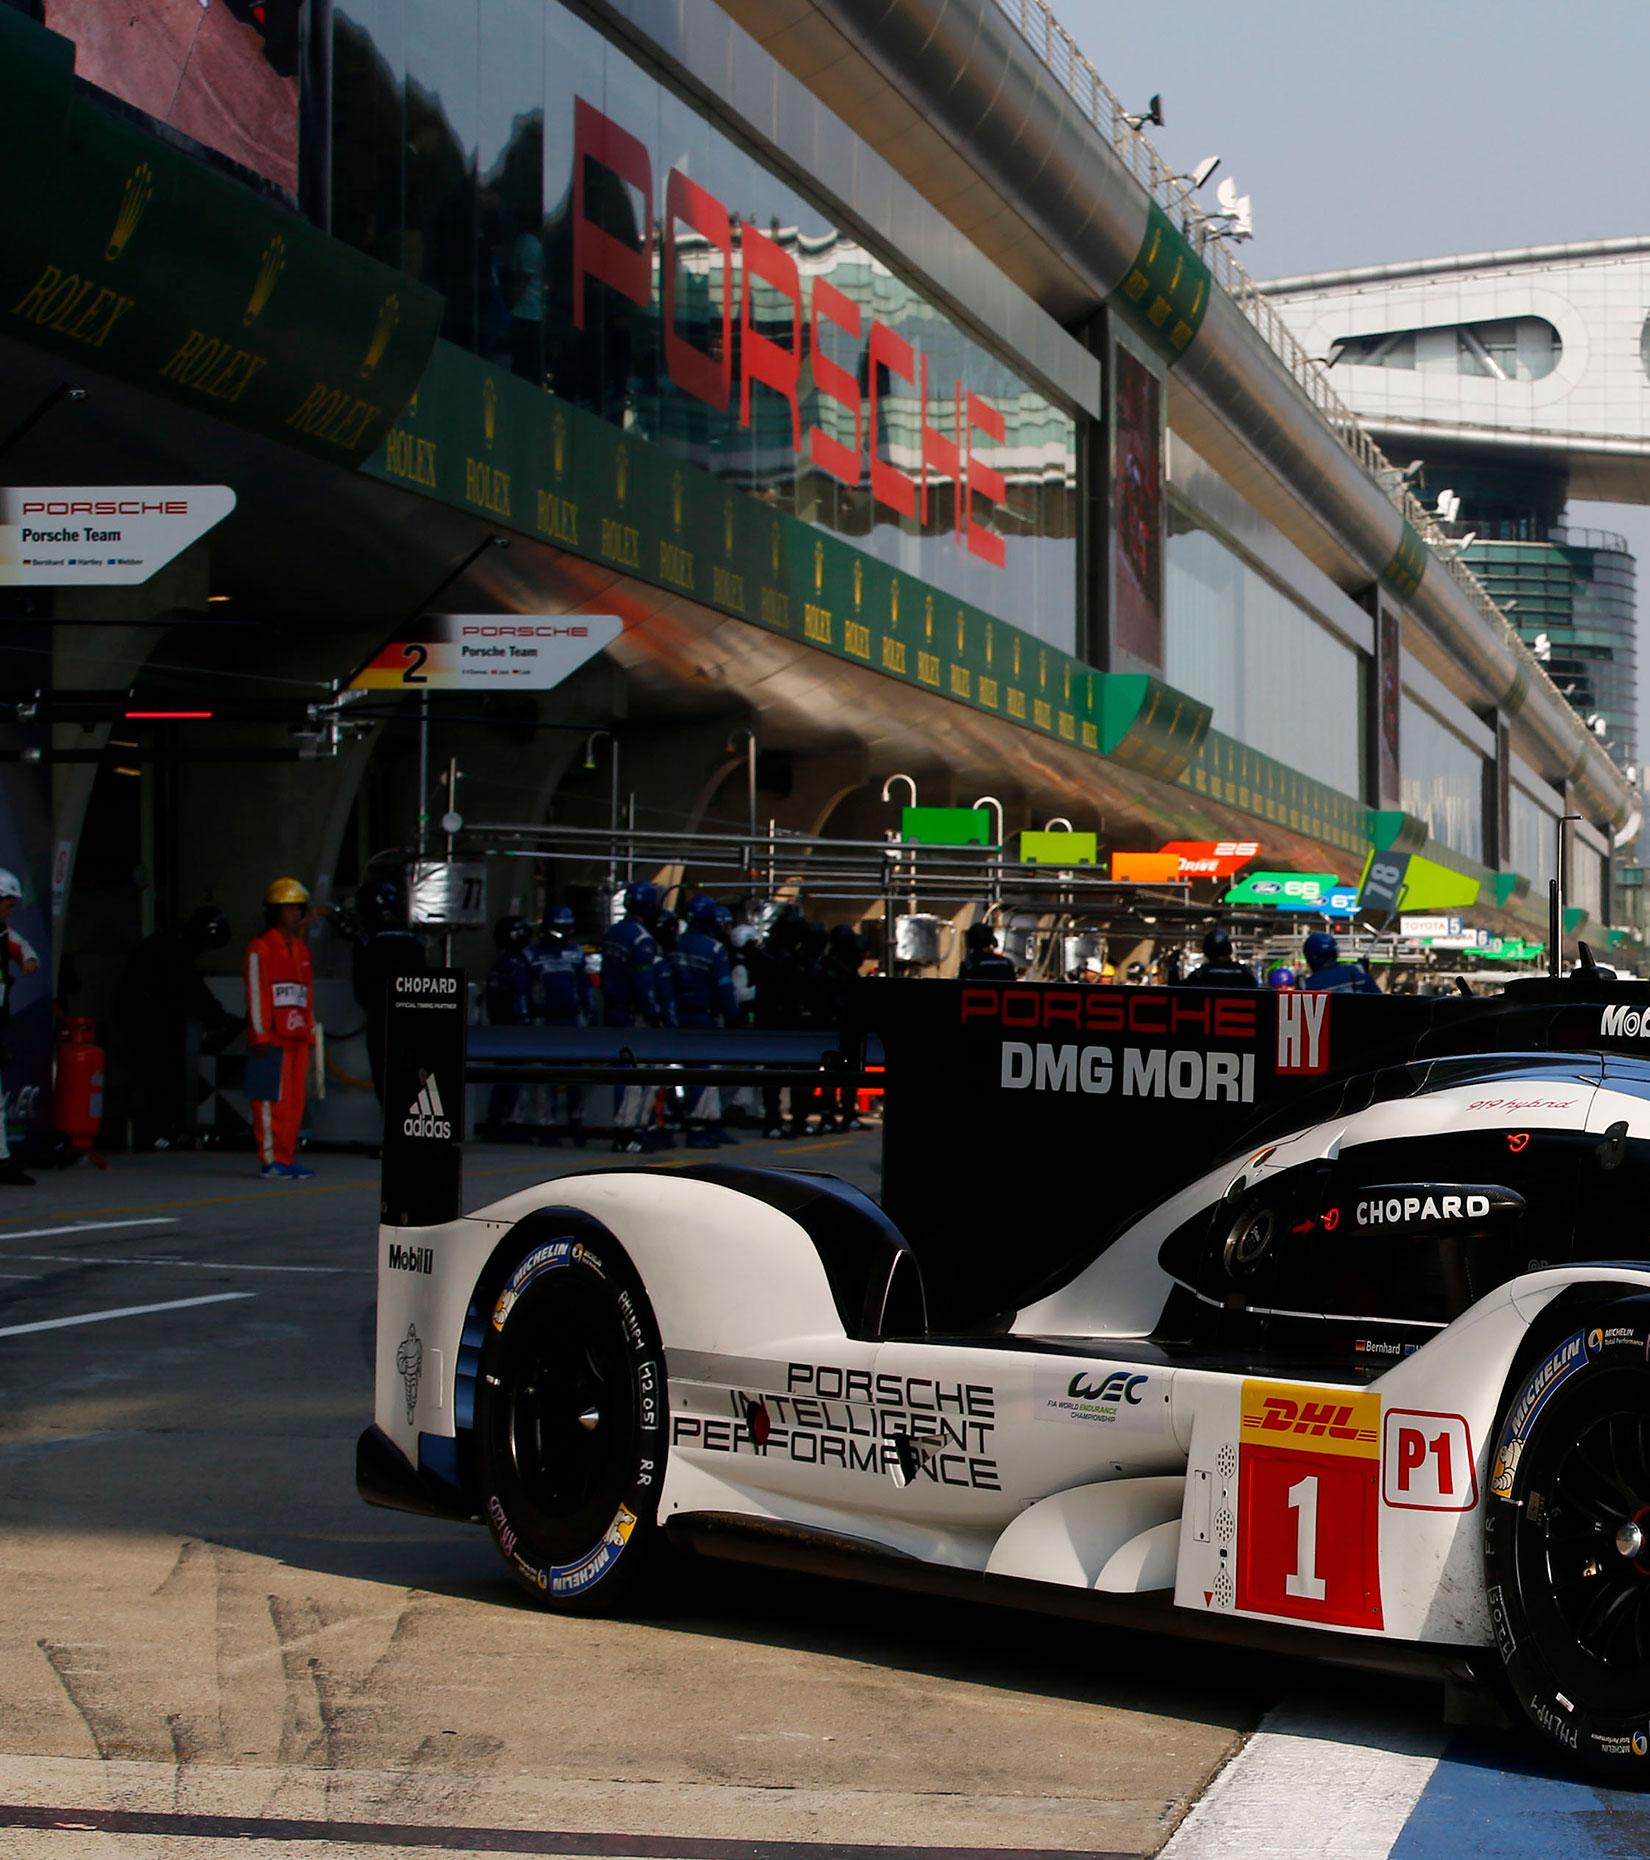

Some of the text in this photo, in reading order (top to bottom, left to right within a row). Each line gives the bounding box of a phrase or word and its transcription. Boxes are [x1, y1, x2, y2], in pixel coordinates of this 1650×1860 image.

[11, 264, 135, 348] ROLEX
[573, 93, 1005, 569] PORSCHE
[160, 329, 268, 403] ROLEX
[285, 382, 382, 451] ROLEX
[386, 427, 438, 489] ROLEX
[465, 457, 511, 517] ROLEX
[23, 502, 188, 515] PORSCHE
[536, 489, 579, 546] ROLEX
[22, 528, 121, 542] Porsche Team
[600, 517, 640, 568] ROLEX
[659, 540, 695, 591] ROLEX
[462, 626, 589, 637] PORSCHE
[804, 602, 833, 645] ROLEX
[844, 619, 871, 661] ROLEX
[402, 644, 428, 683] 2
[461, 646, 538, 656] Porsche Team
[882, 635, 907, 674] ROLEX
[1213, 842, 1259, 856] 26
[1363, 862, 1400, 899] 78
[1405, 922, 1446, 930] TOYOTA
[1449, 918, 1461, 934] 5
[1478, 930, 1489, 946] 6
[395, 976, 457, 993] CHOPARD
[960, 988, 1257, 1038] PORSCHE
[1277, 994, 1329, 1068] HY
[1001, 1040, 1255, 1103] DMG MORI
[403, 1114, 452, 1139] adidas
[1466, 1097, 1581, 1115] 919 hybrid
[1356, 1195, 1491, 1226] CHOPARD
[389, 1244, 423, 1272] Mobil
[512, 1242, 571, 1285] MICHELIN
[1366, 1341, 1400, 1355] Bernhard
[1604, 1328, 1635, 1337] MICHELIN
[788, 1363, 995, 1418] PORSCHE
[1068, 1371, 1149, 1405] WEC
[1510, 1336, 1582, 1434] MICHELIN
[730, 1390, 995, 1453] INTELLIGENT
[1058, 1401, 1079, 1411] WORLD
[1079, 1404, 1118, 1415] ENDURANCE
[1071, 1412, 1116, 1422] CHAMPIONSHIP
[1260, 1397, 1360, 1440] DHL
[1397, 1428, 1454, 1495] P1
[1285, 1475, 1327, 1601] 1
[552, 1545, 611, 1591] MICHELIN
